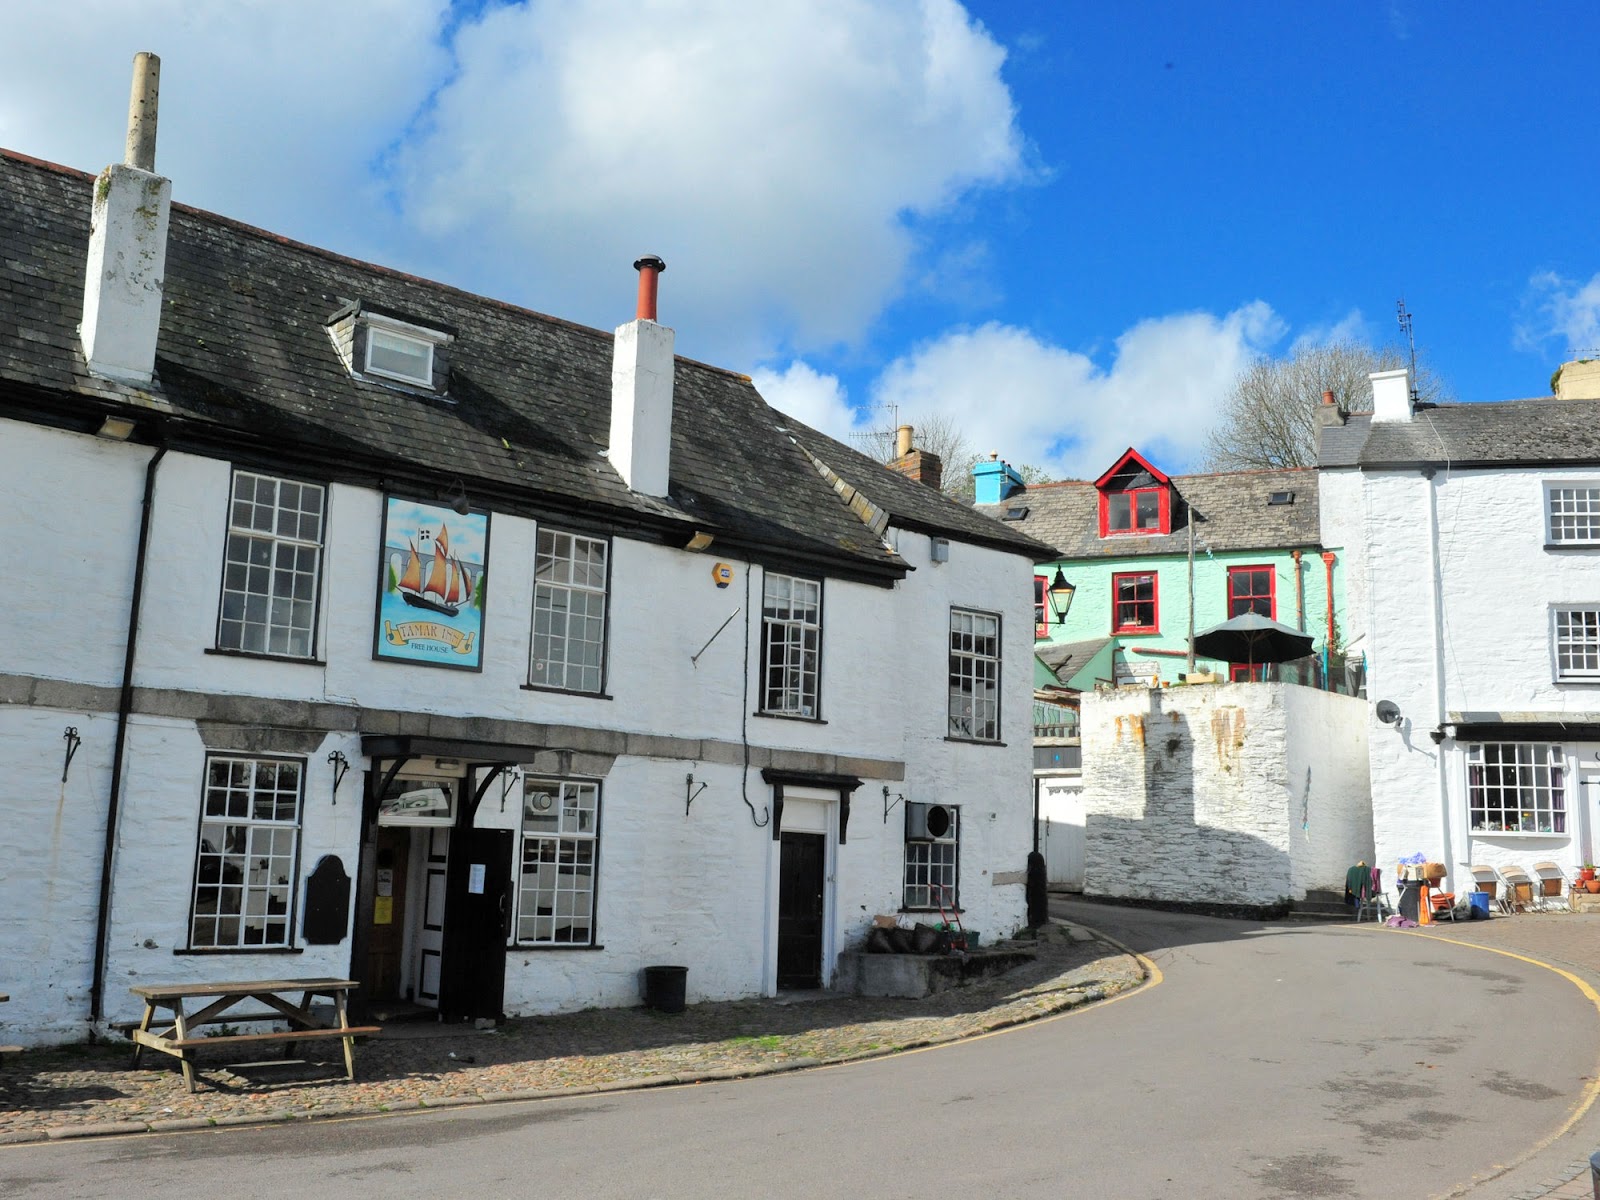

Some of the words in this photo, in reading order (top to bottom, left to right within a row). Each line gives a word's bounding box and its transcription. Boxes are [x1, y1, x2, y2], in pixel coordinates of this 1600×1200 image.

[400, 624, 437, 637] TAMAR
[411, 642, 425, 650] FREE
[426, 644, 449, 653] HOUSE
